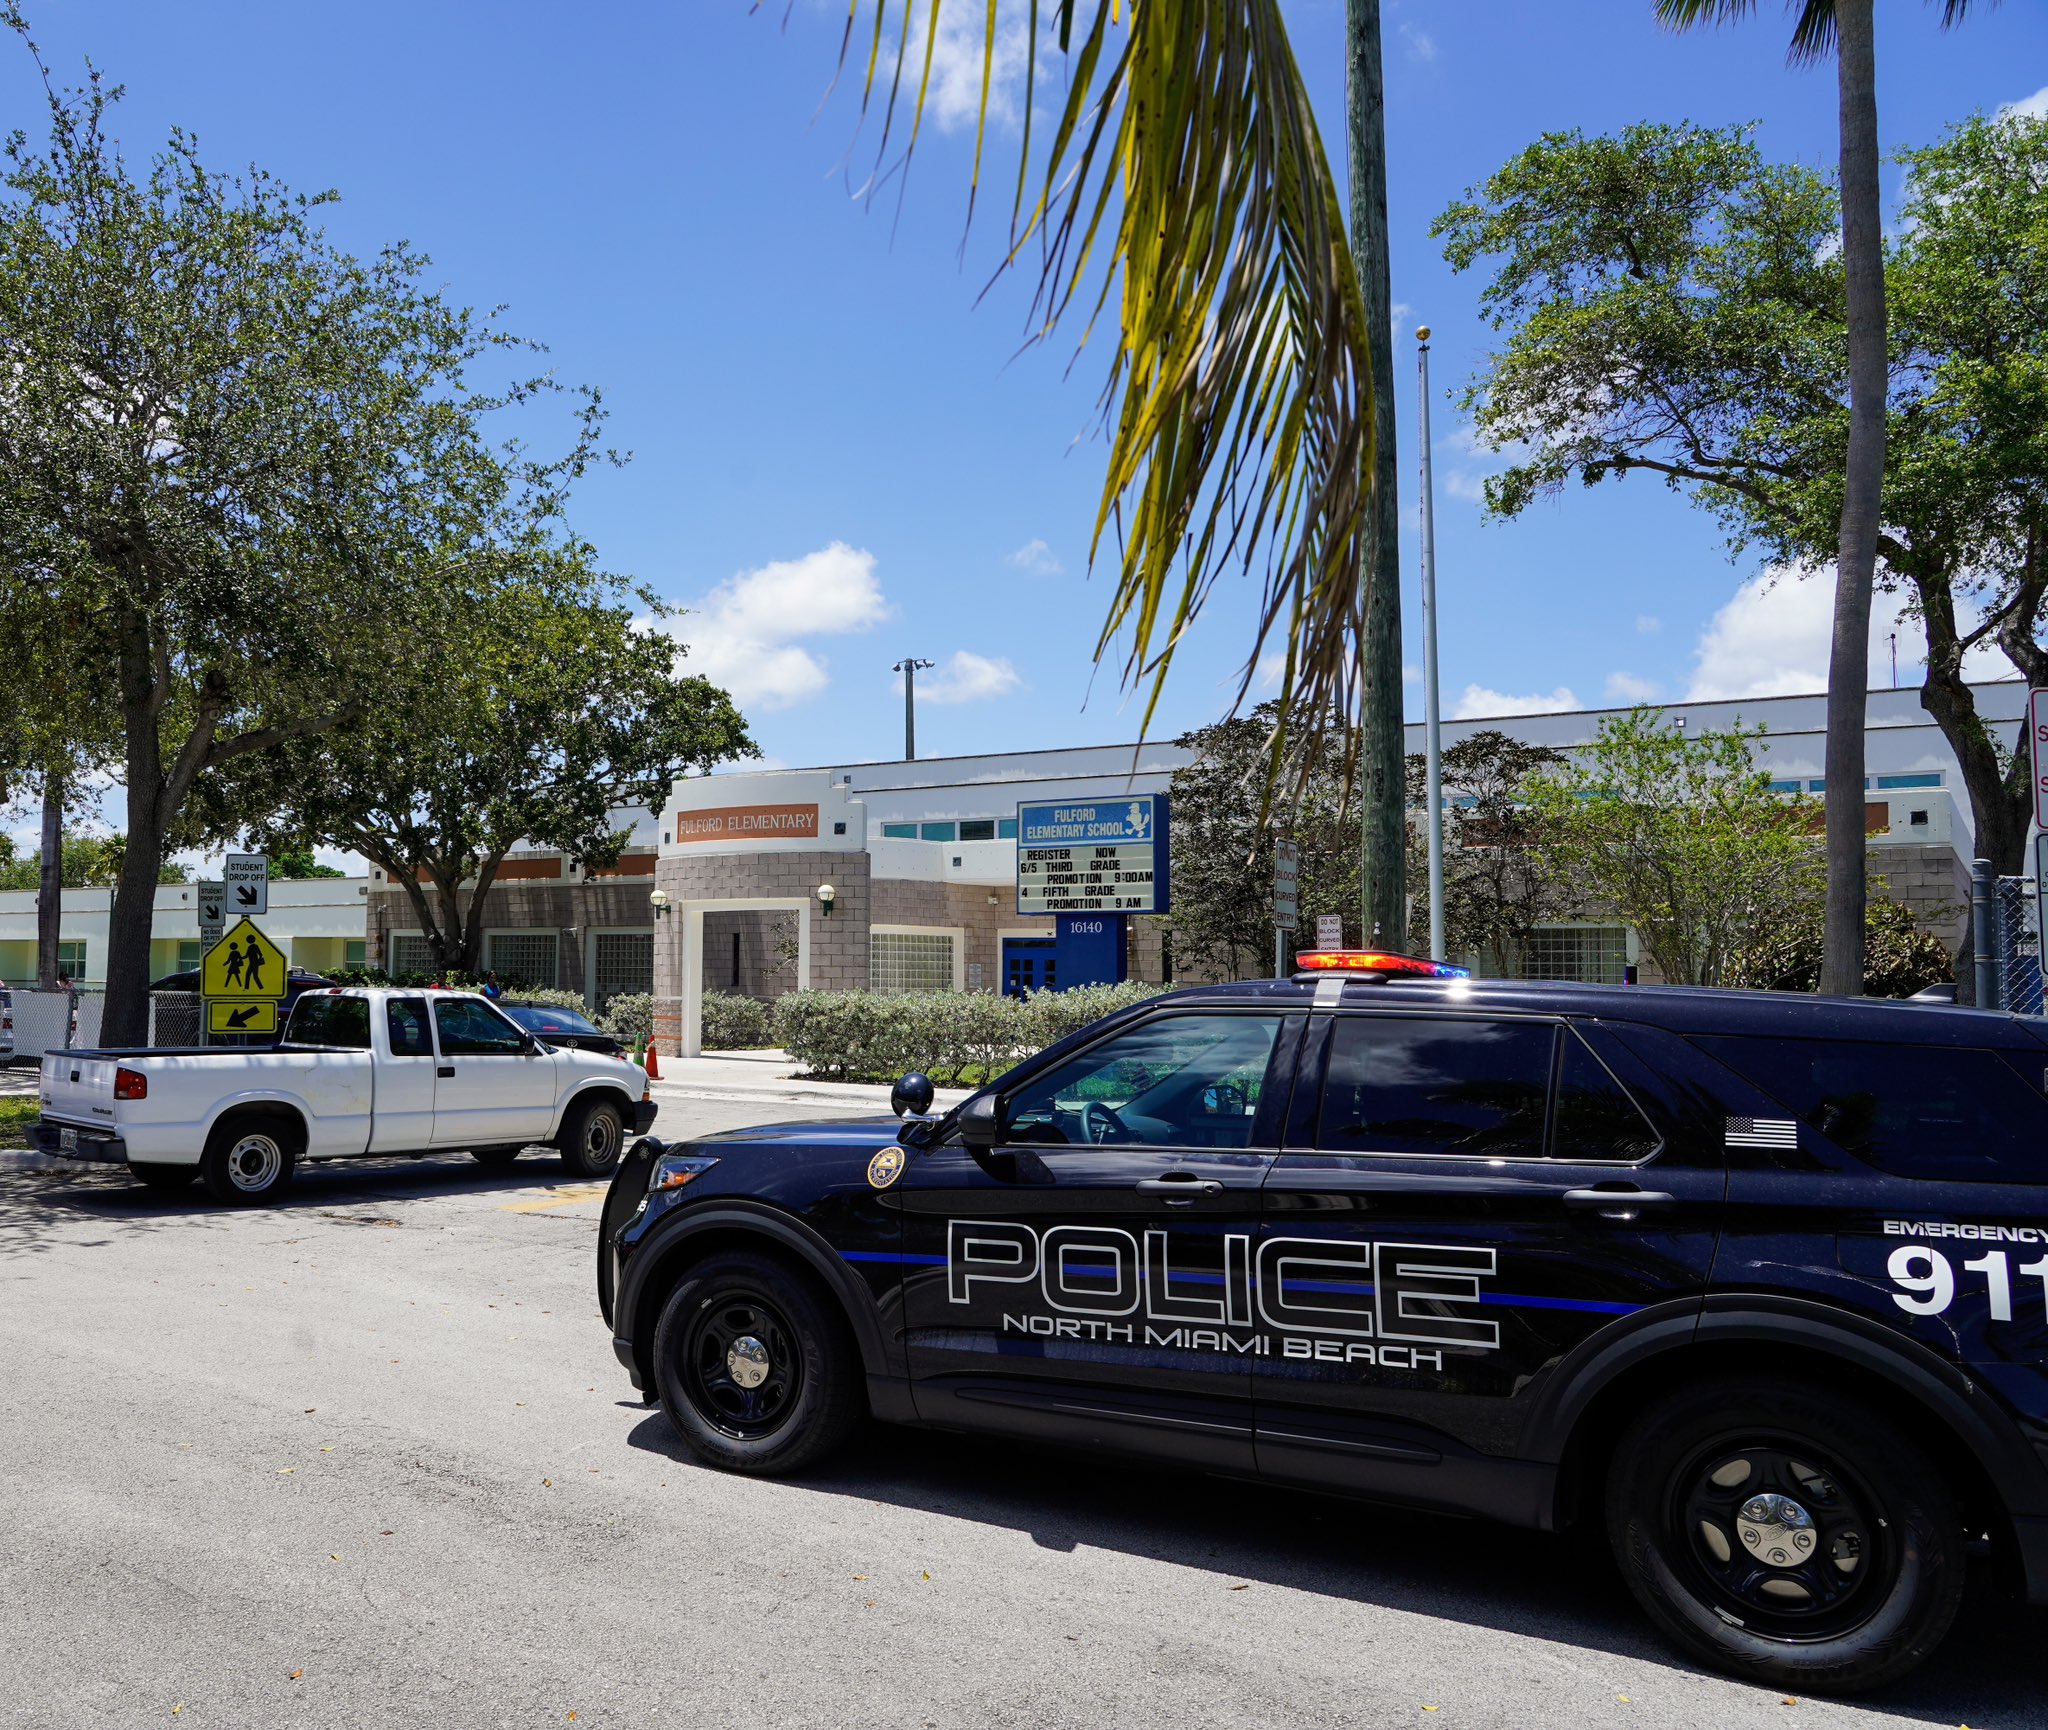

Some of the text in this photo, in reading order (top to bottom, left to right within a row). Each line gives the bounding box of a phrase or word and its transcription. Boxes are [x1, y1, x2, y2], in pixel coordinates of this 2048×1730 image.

[1054, 808, 1096, 823] FULFORD
[680, 813, 815, 835] FULFORD ELEMENTARY
[1026, 821, 1125, 839] ELEMENTARY SCHOOL
[1027, 847, 1117, 861] REGISTER NOW
[230, 863, 264, 871] STUDENT
[1020, 860, 1121, 873] 6/5 THIRD GRADE
[229, 873, 265, 881] DROP OFF
[1047, 871, 1153, 885] PROMOTION 9:00AM
[1276, 869, 1296, 882] BLOCK
[1021, 885, 1115, 897] 4 FIFTH GRADE
[1047, 898, 1141, 909] PROMOTION 9 AM
[1277, 912, 1295, 923] ENTRY
[1070, 921, 1103, 933] 16140
[947, 1219, 1500, 1349] POLICE
[1003, 1312, 1442, 1371] NORTH MIAMI BEACH
